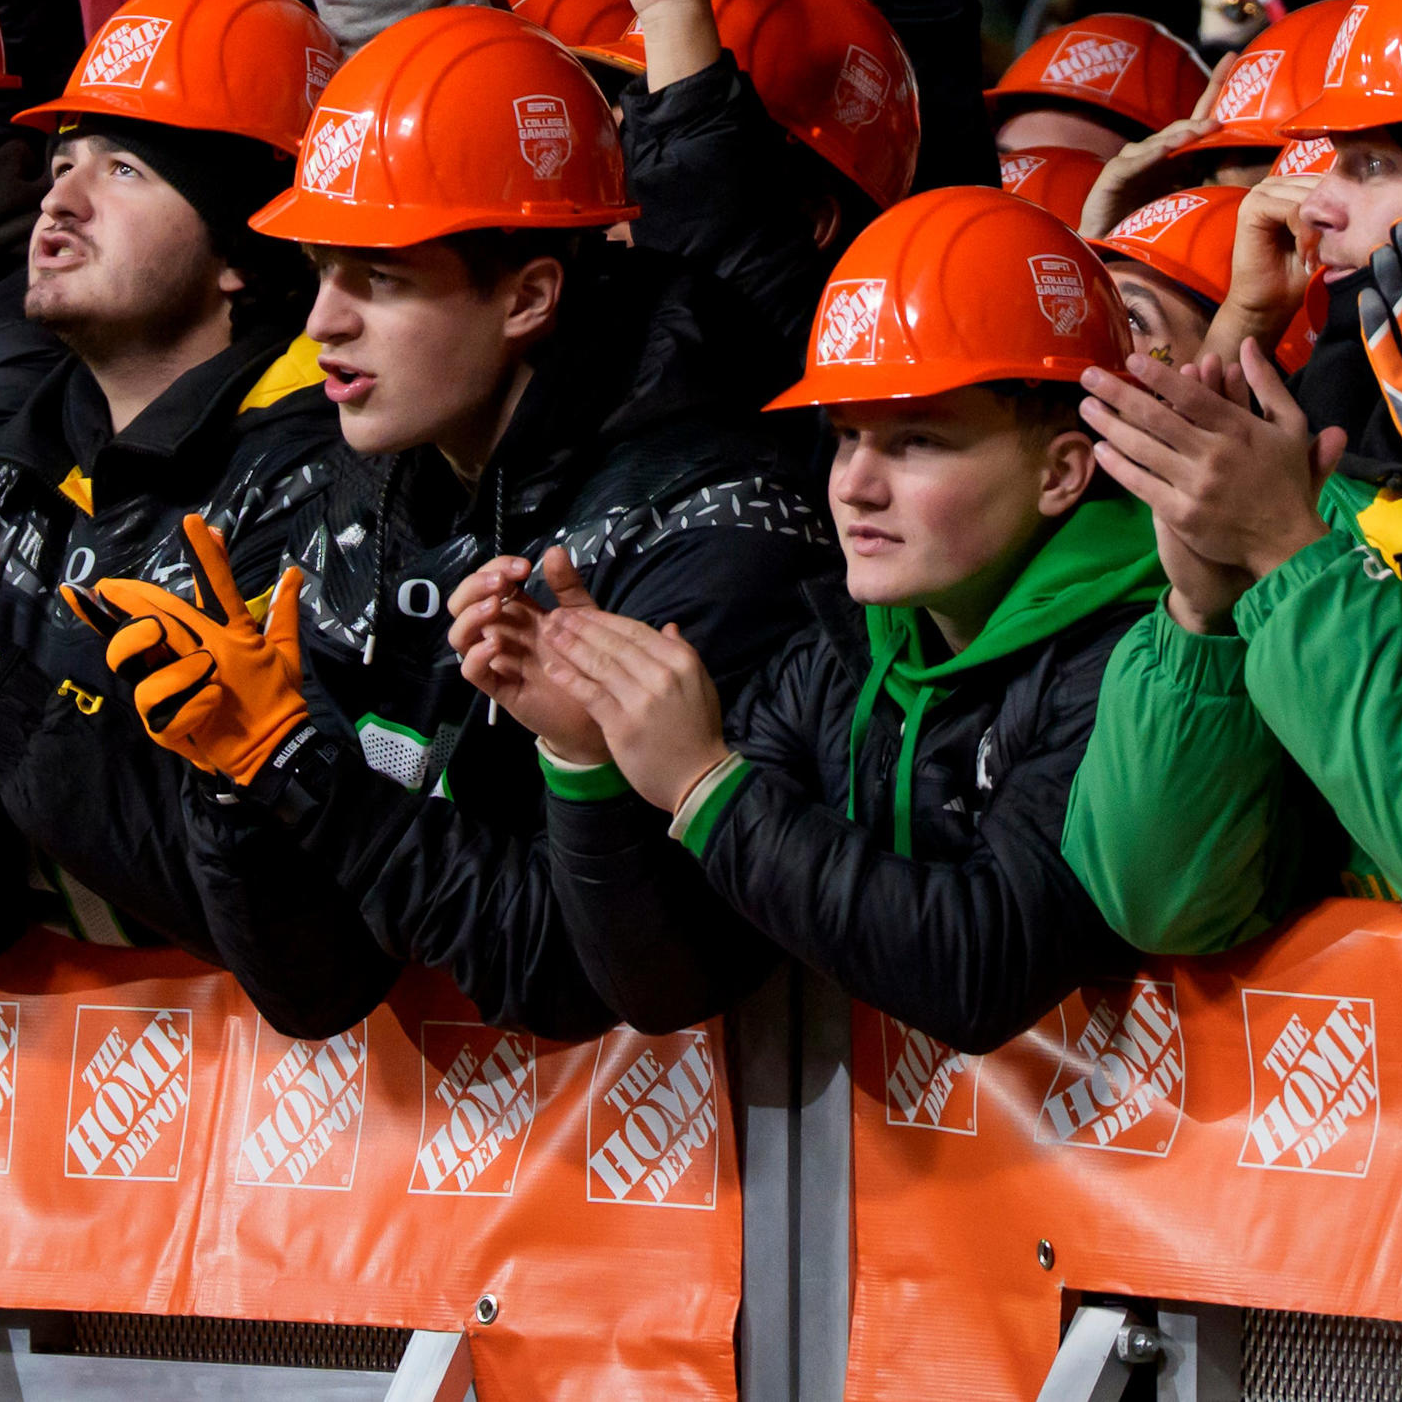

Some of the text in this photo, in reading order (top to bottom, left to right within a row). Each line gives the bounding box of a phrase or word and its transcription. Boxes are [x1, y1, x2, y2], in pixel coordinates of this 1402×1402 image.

[84, 18, 166, 83] HOME
[101, 22, 131, 47] THE
[102, 40, 156, 83] DEPOT
[1048, 40, 1132, 81] HOME
[1071, 58, 1122, 85] DEPOT
[1216, 55, 1279, 121] HOME
[312, 118, 336, 149] THE
[519, 128, 570, 140] GAMEDAY
[524, 118, 565, 128] COLLEGE
[526, 102, 557, 112] ESPN
[304, 112, 368, 190] HOME
[318, 143, 359, 192] DEPOT
[1035, 285, 1086, 298] GAMEDAY
[1040, 275, 1079, 286] COLLEGE
[1041, 261, 1071, 271] ESPN
[819, 281, 884, 363] HOME
[834, 309, 876, 360] DEPOT
[65, 547, 96, 584] O
[397, 578, 440, 619] O
[272, 739, 302, 769] COLLEGE
[81, 1027, 129, 1093] THE
[1044, 982, 1178, 1141] HOME
[1077, 999, 1119, 1059] THE
[1263, 1013, 1312, 1080] THE
[67, 1011, 190, 1176] HOME
[263, 1041, 313, 1099] THE
[435, 1043, 479, 1110] THE
[604, 1049, 665, 1116] THE
[1092, 1047, 1183, 1146] DEPOT
[1248, 1000, 1374, 1166] HOME
[111, 1073, 188, 1177] DEPOT
[241, 1029, 365, 1183] HOME
[284, 1083, 364, 1185] DEPOT
[418, 1032, 535, 1191] HOME
[589, 1033, 714, 1200] HOME
[1294, 1065, 1377, 1168] DEPOT
[454, 1089, 534, 1192] DEPOT
[643, 1097, 718, 1202] DEPOT
